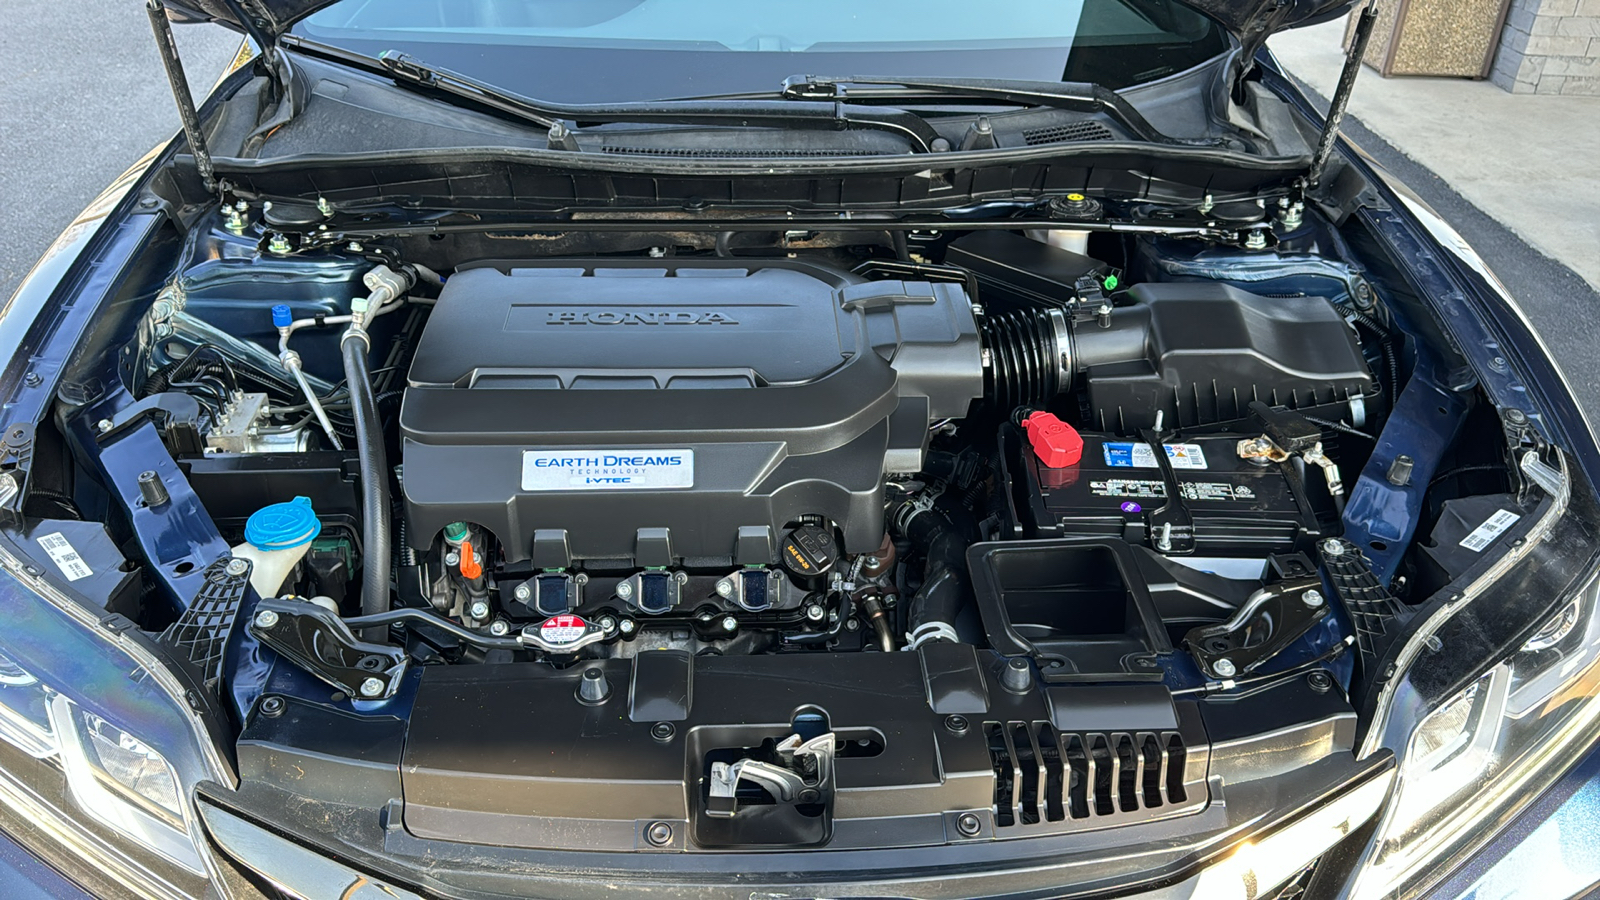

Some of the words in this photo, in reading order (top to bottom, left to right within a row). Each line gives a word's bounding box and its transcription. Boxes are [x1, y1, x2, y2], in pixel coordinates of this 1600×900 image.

[546, 311, 739, 325] HONDA
[534, 457, 598, 468] EARTH
[603, 455, 682, 467] DREAMS
